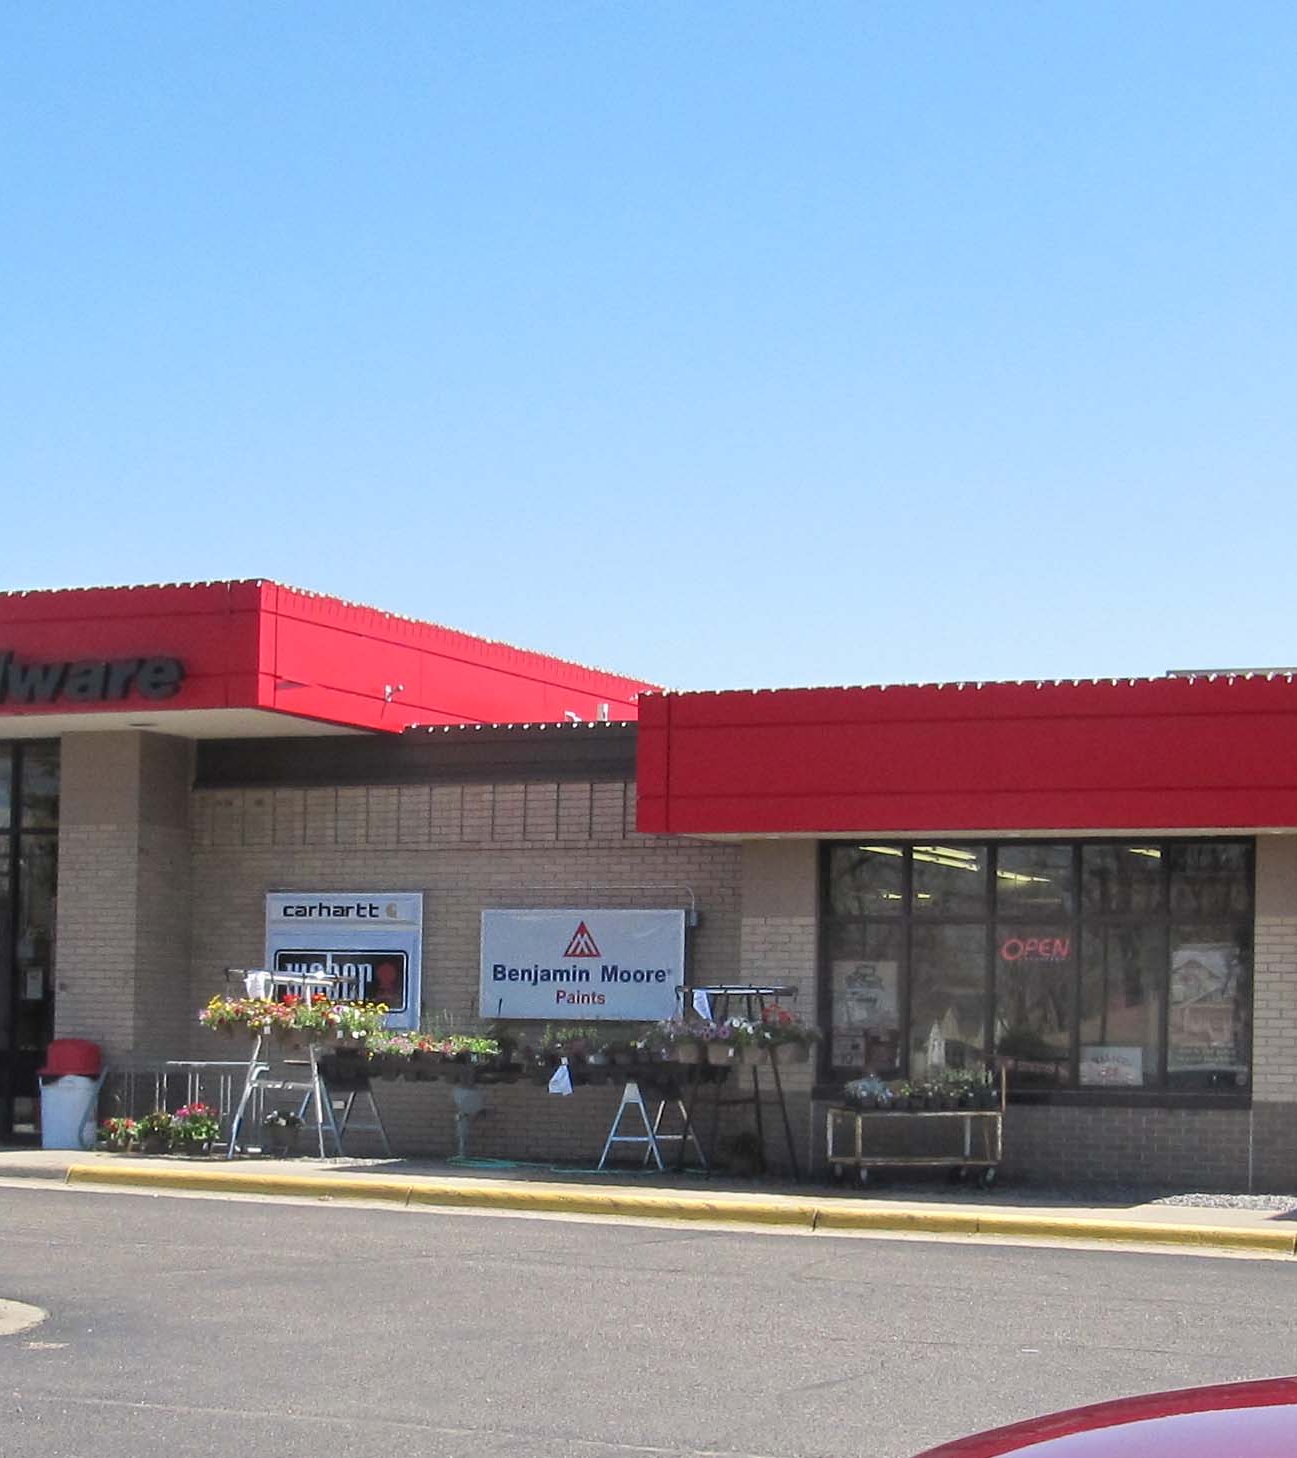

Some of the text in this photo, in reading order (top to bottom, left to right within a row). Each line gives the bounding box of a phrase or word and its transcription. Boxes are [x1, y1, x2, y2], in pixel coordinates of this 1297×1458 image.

[282, 902, 379, 918] carhartt
[1000, 938, 1070, 960] OPEN
[492, 964, 666, 986] Benjamin Moore
[556, 989, 606, 1005] Paints
